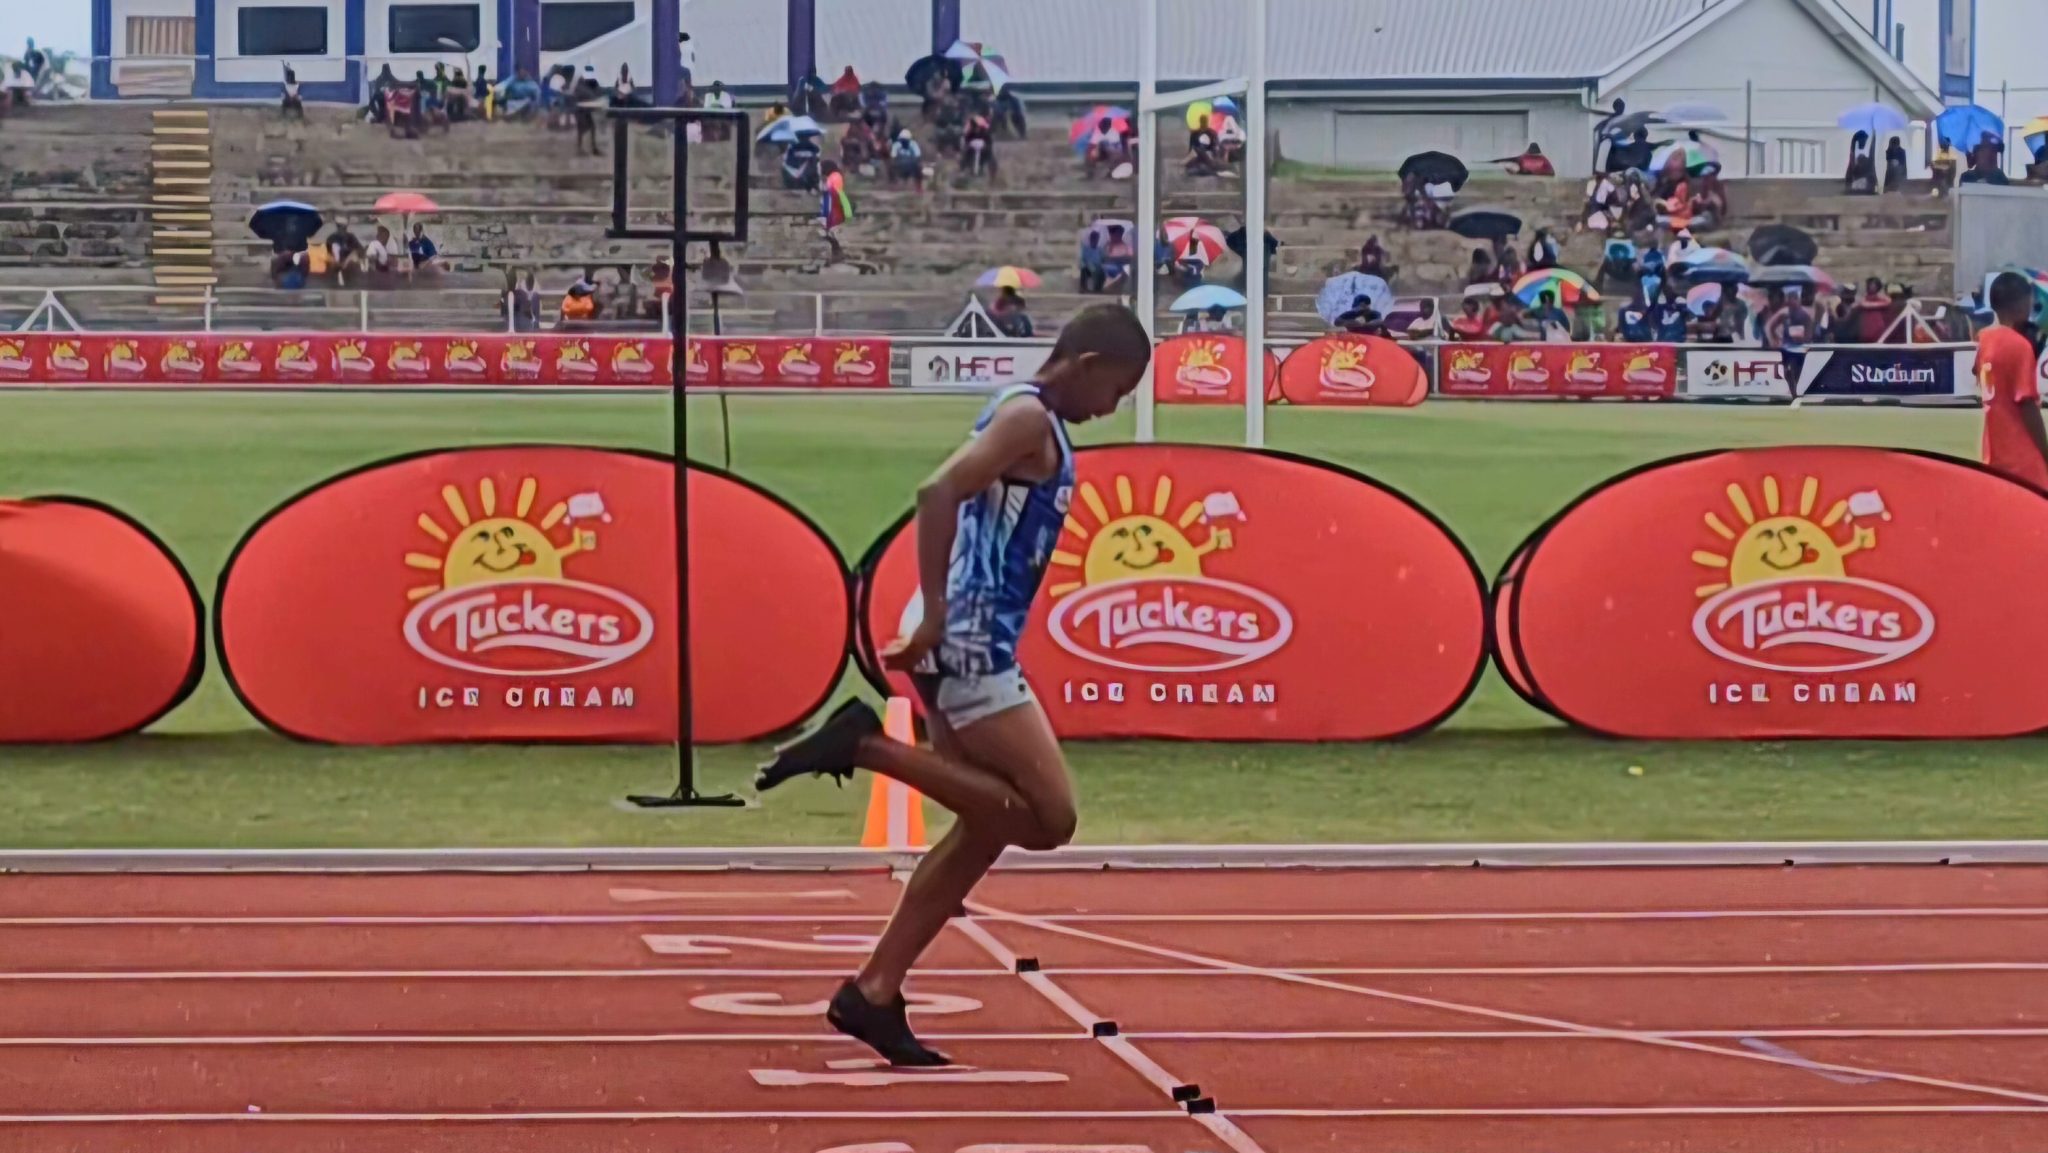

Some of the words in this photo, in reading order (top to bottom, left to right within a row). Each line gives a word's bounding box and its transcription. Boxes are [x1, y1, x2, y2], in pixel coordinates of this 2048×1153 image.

[955, 356, 1015, 380] HFC
[430, 589, 621, 651] Tuckers
[1072, 586, 1260, 649] Tuckers
[1717, 588, 1902, 649] Tuckers
